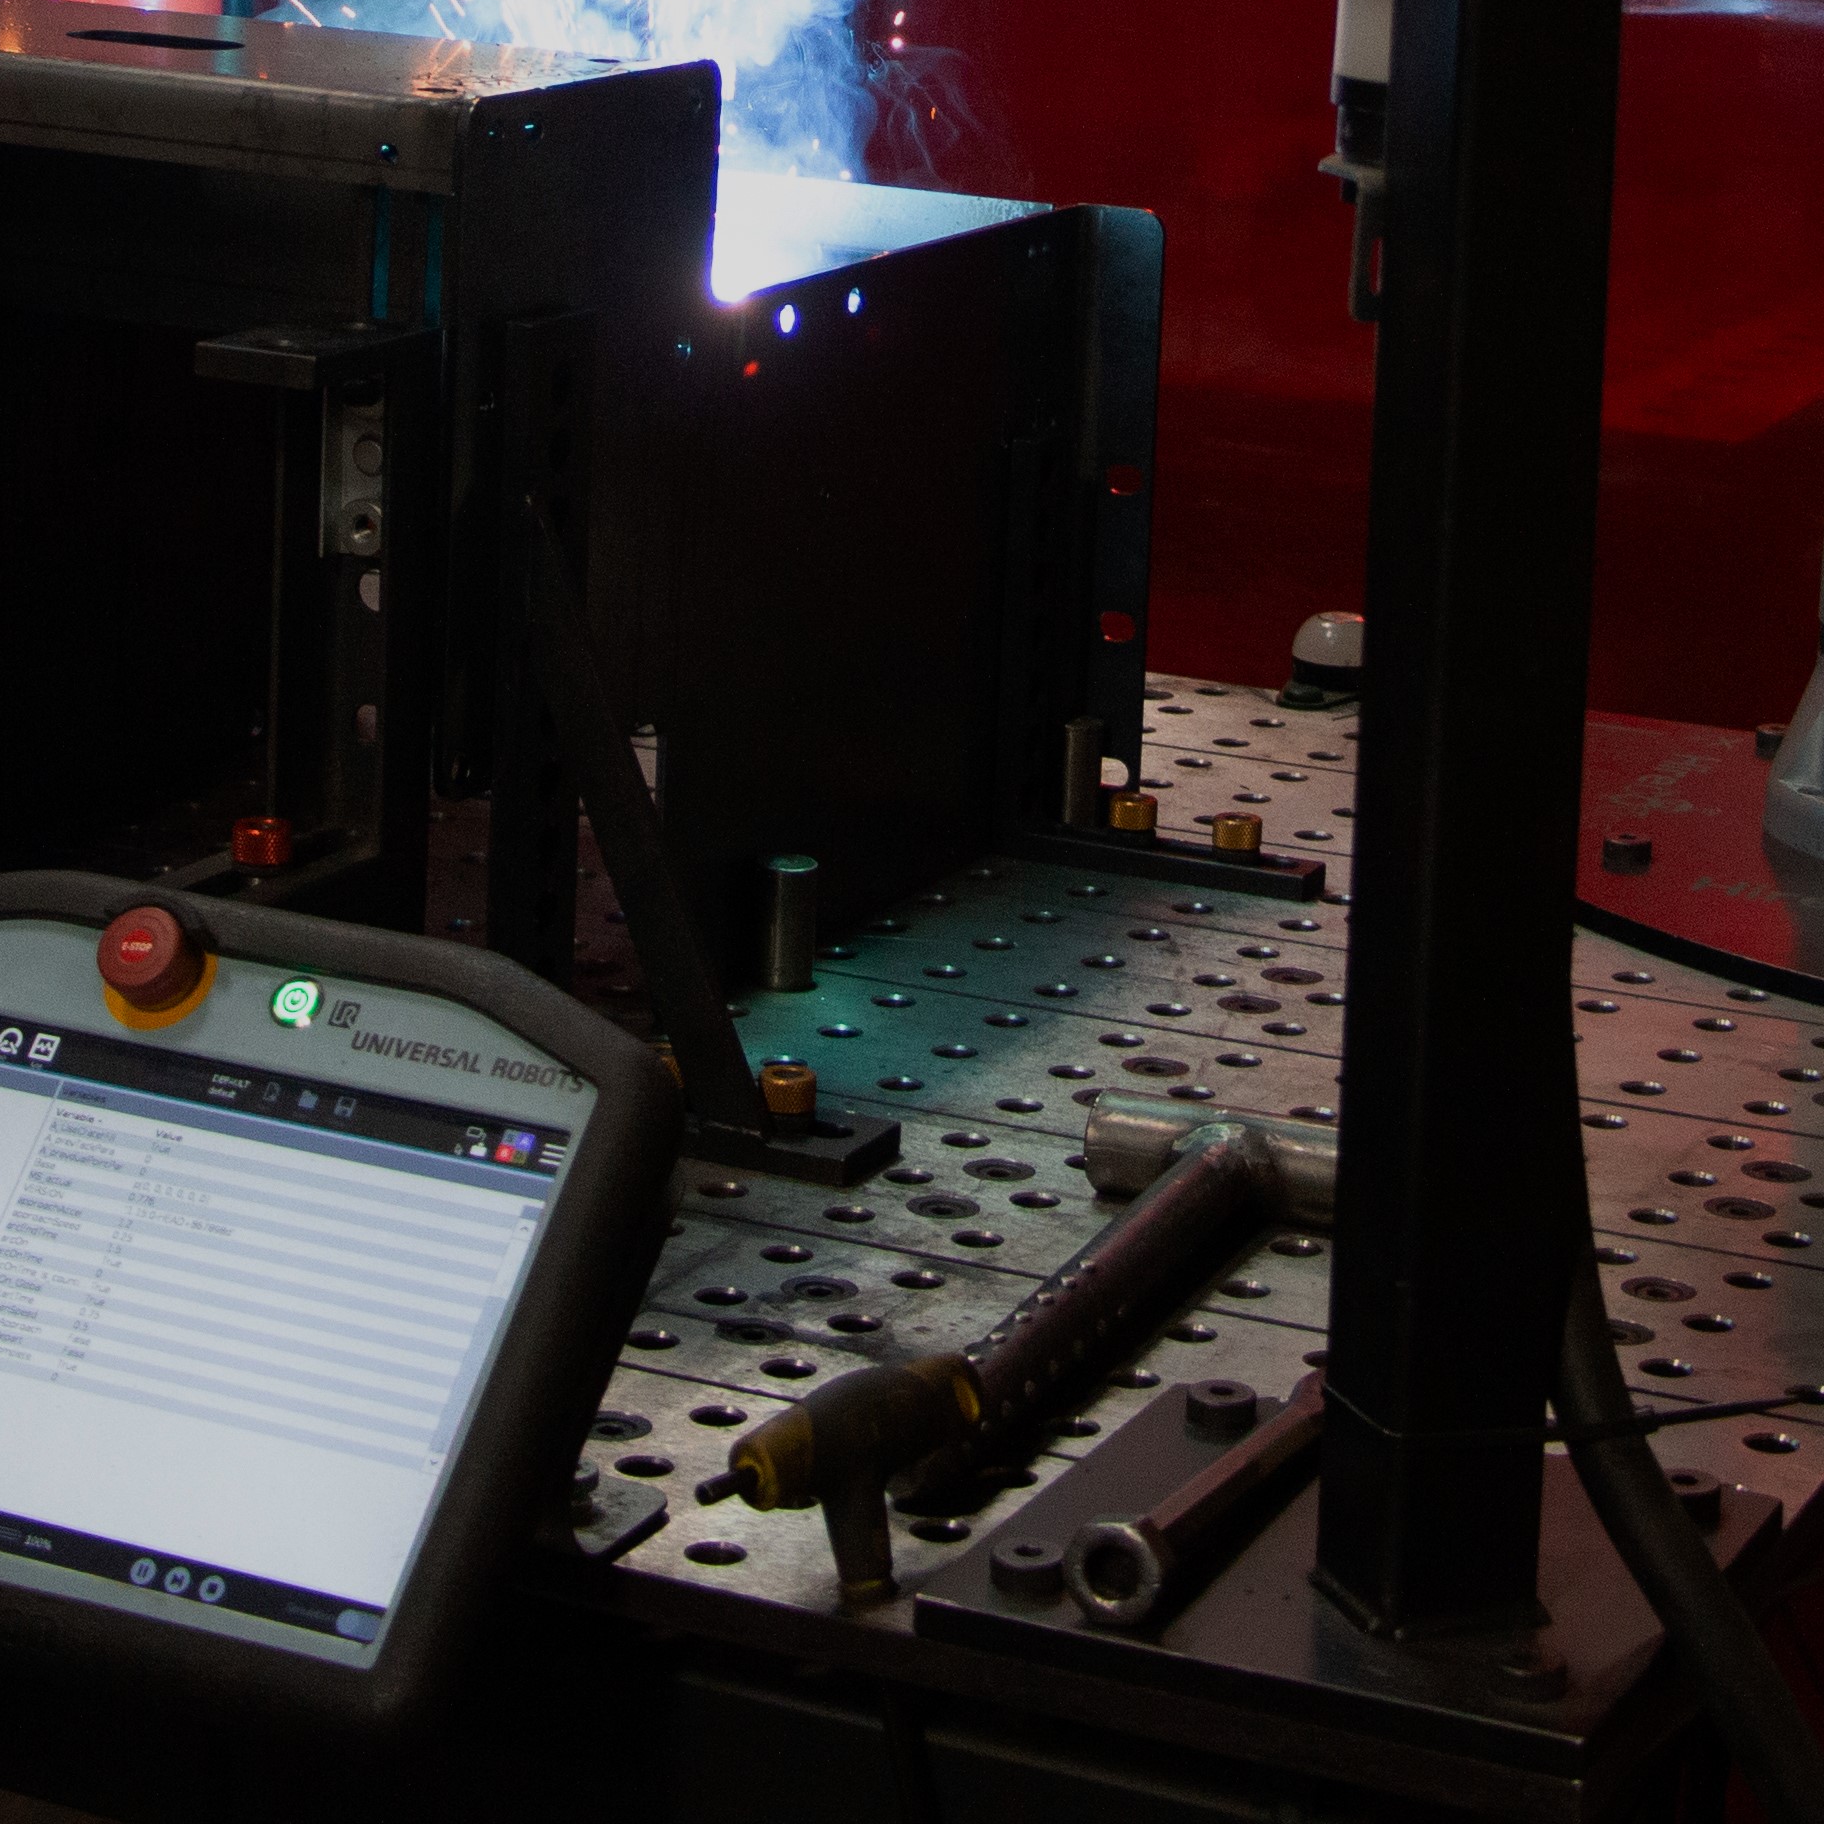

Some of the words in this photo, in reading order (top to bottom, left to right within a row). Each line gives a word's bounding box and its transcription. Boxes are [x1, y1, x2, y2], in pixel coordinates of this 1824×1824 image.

[120, 938, 154, 954] E-STOP
[350, 1029, 481, 1074] UNIVERSAL
[491, 1056, 586, 1094] ROBOTS
